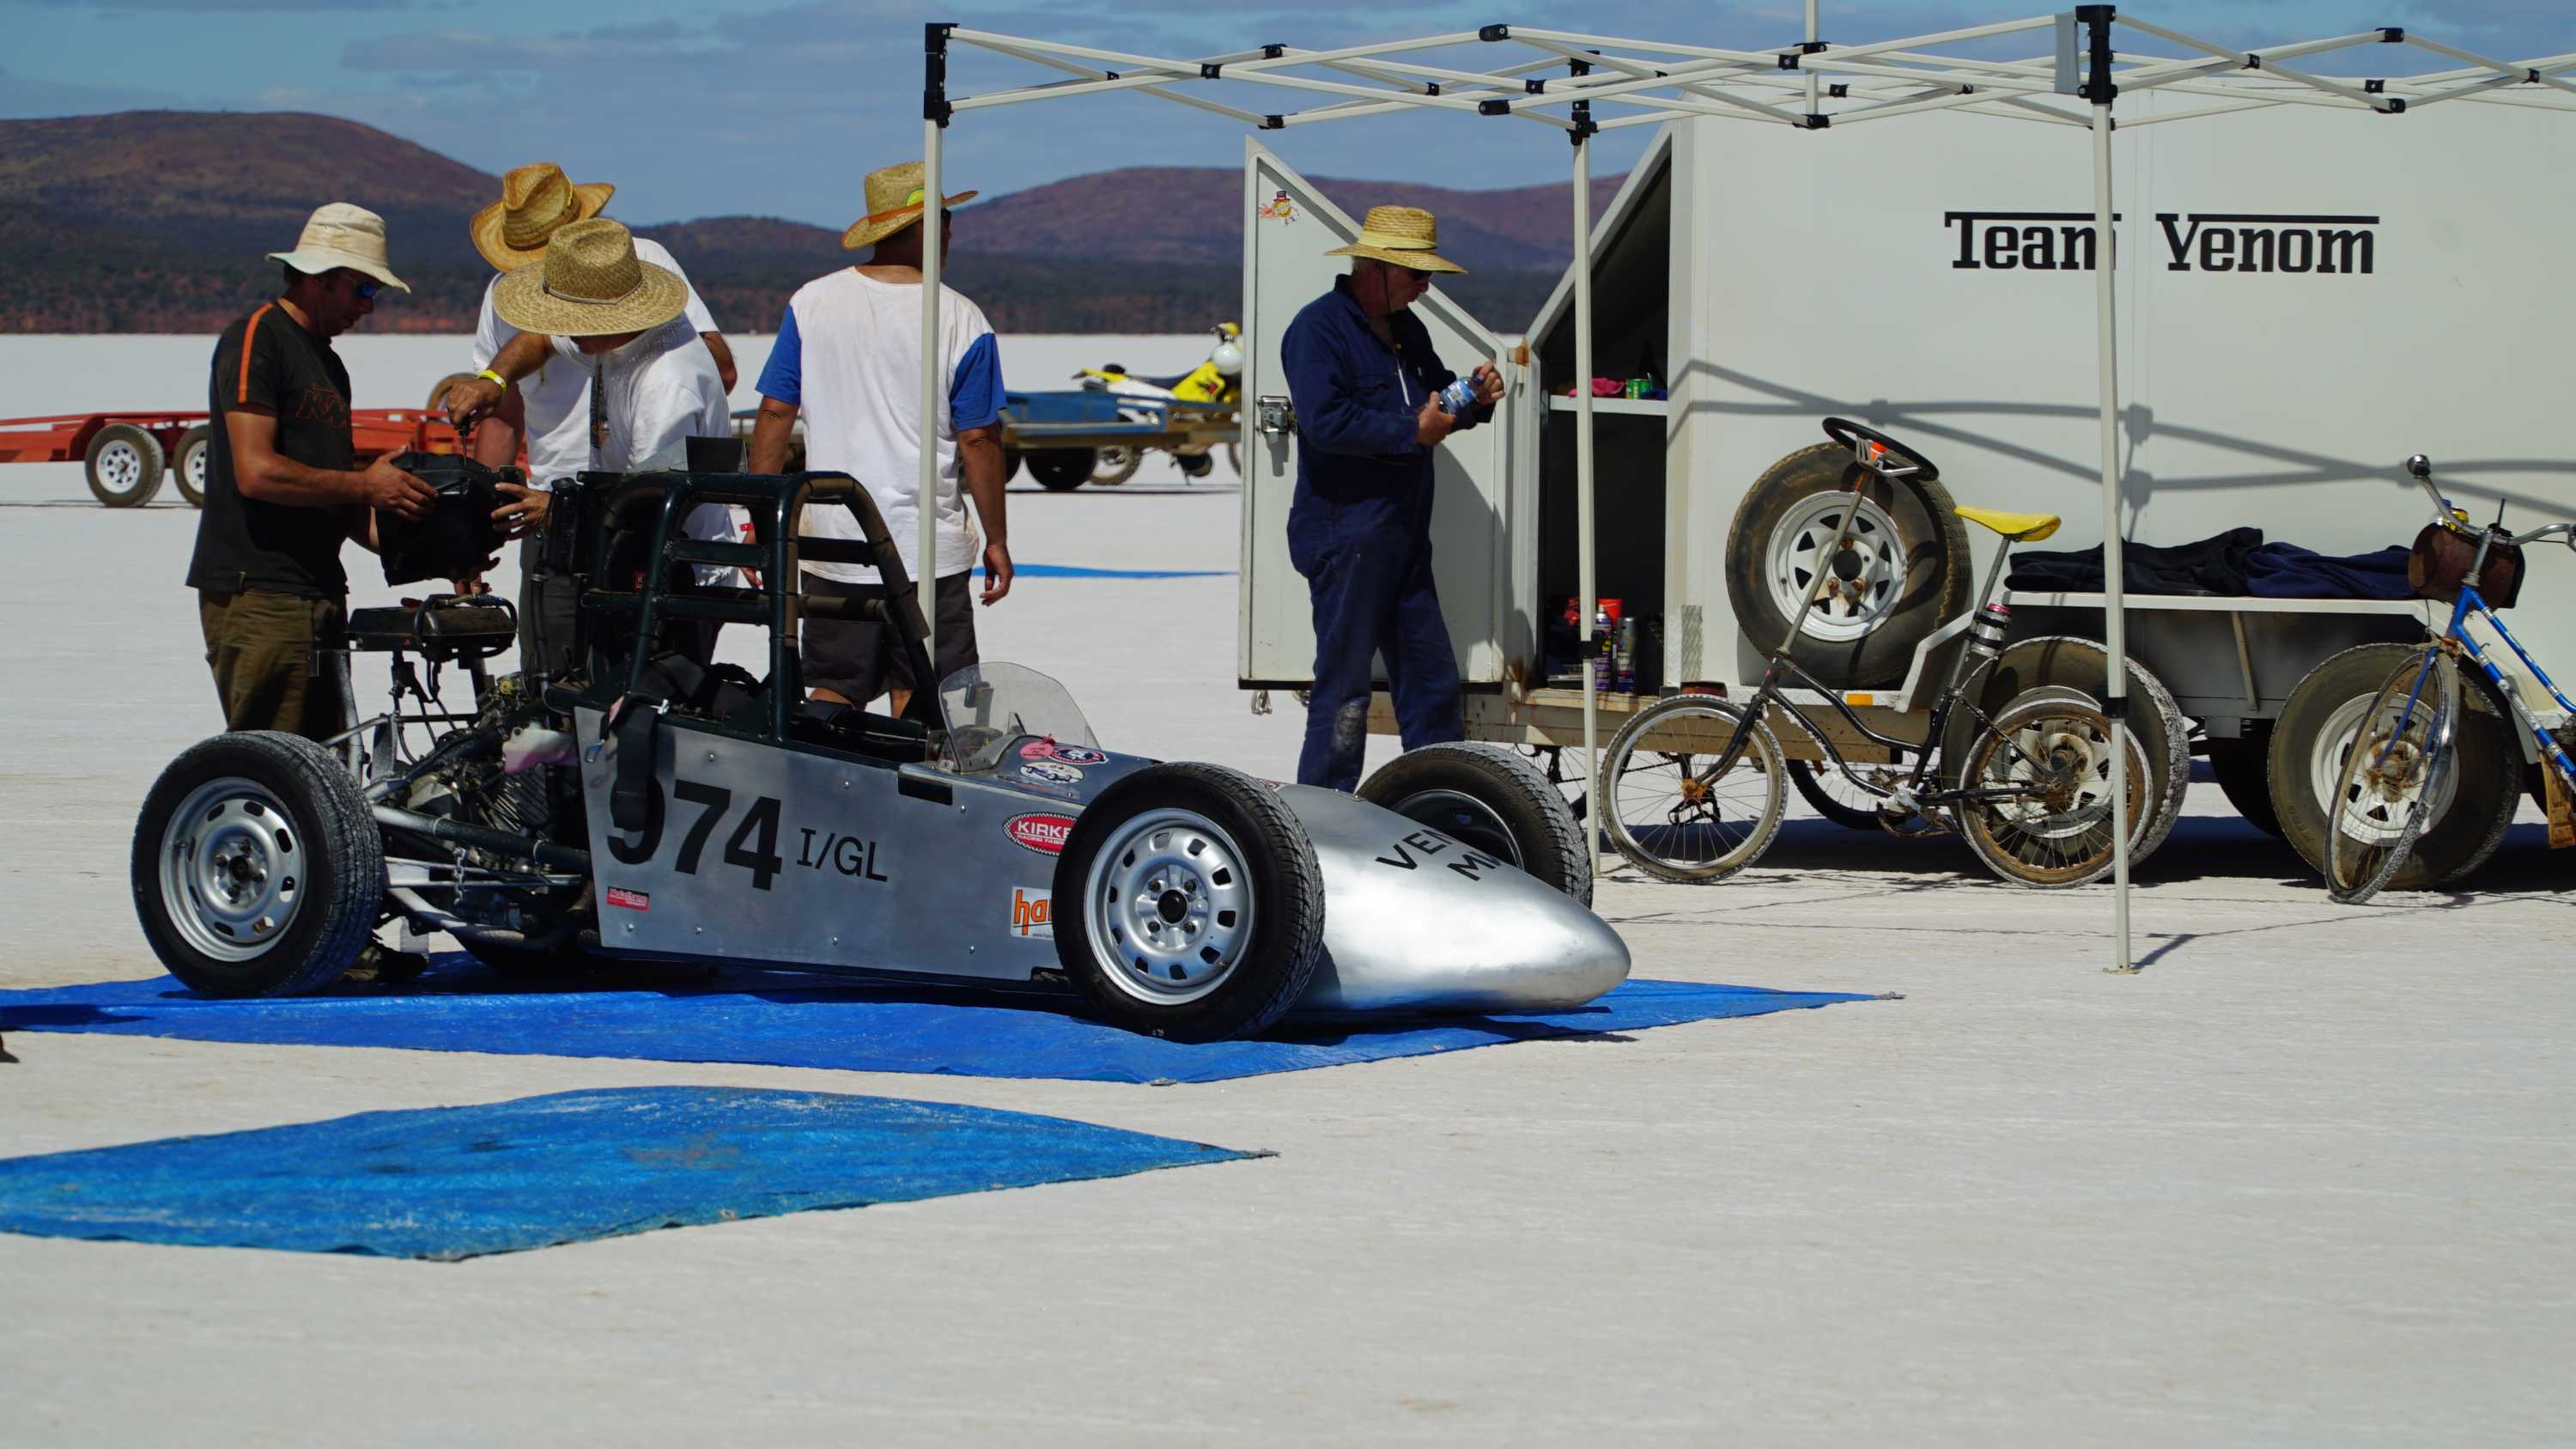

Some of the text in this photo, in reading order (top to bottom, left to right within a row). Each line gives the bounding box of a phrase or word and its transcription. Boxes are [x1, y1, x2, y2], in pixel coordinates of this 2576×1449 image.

[2155, 212, 2380, 275] Venom
[606, 769, 888, 891] 974 I/GL
[1013, 889, 1054, 935] ha
